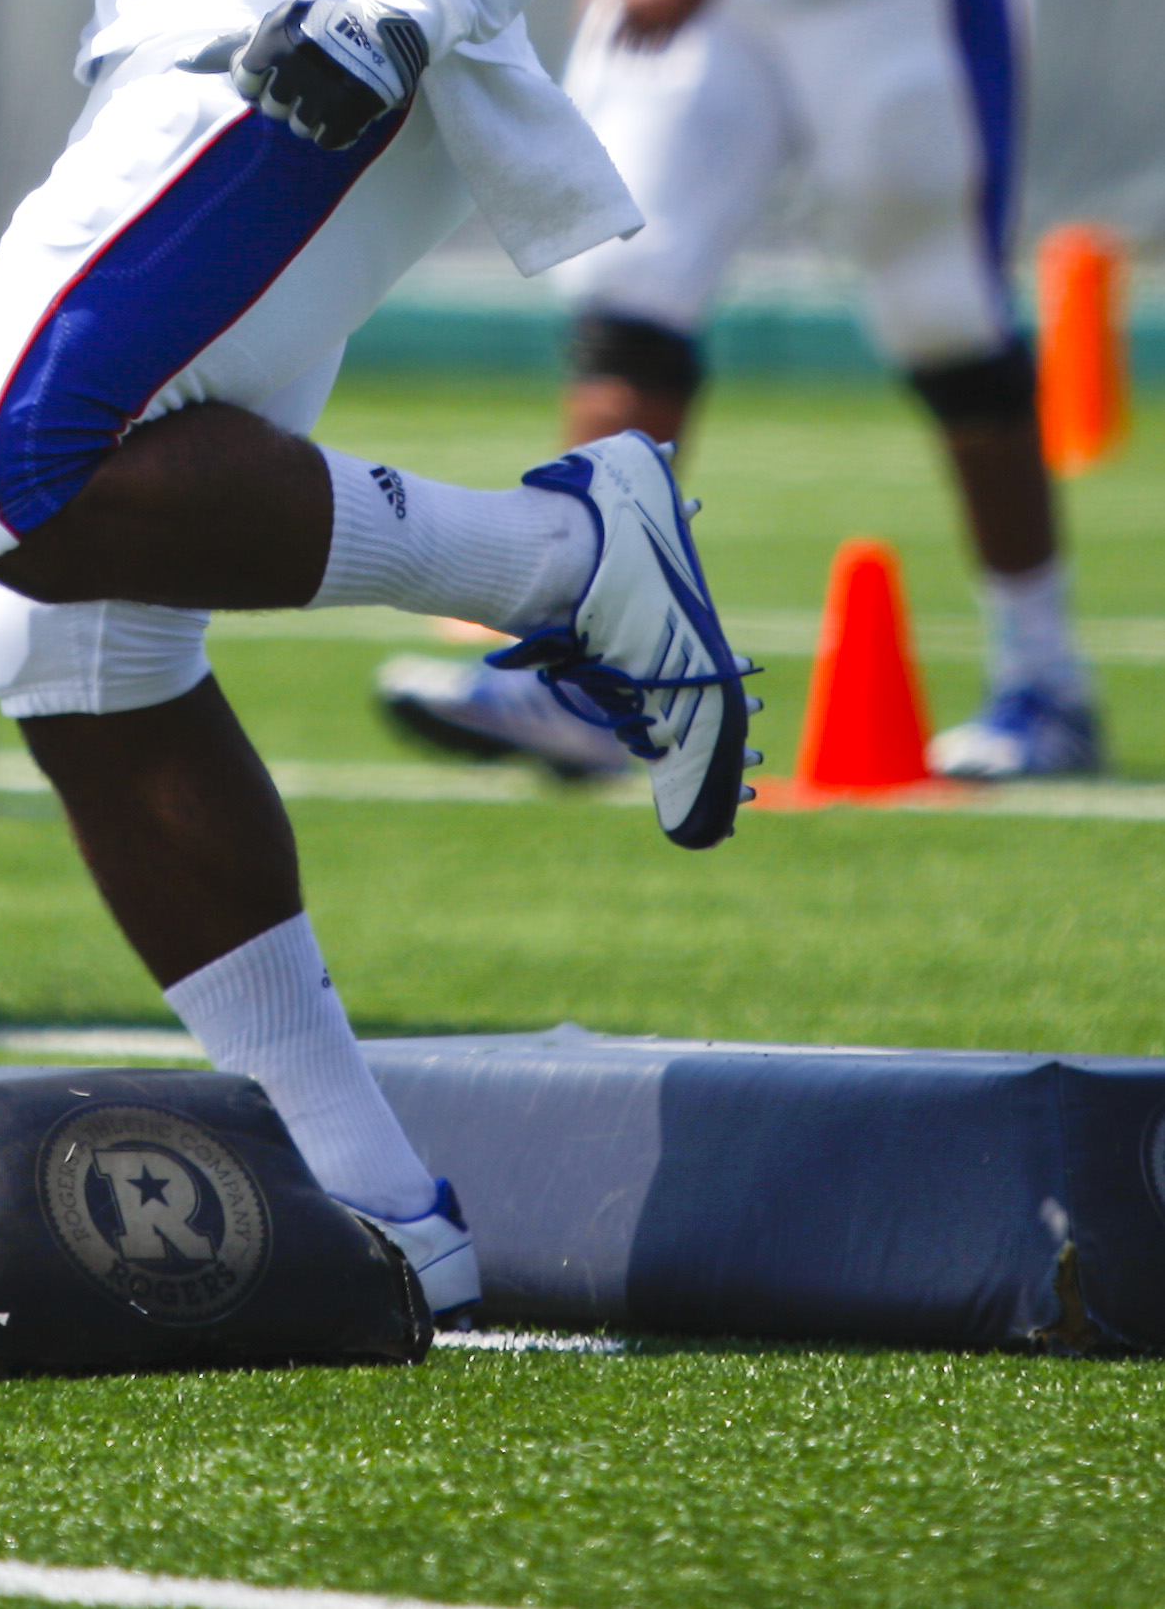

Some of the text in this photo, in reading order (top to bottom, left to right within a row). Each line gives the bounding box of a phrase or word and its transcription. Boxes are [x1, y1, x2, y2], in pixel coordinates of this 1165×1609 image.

[92, 1148, 218, 1263] R
[180, 1132, 252, 1242] COMPANY
[106, 1260, 236, 1306] ROGERS
